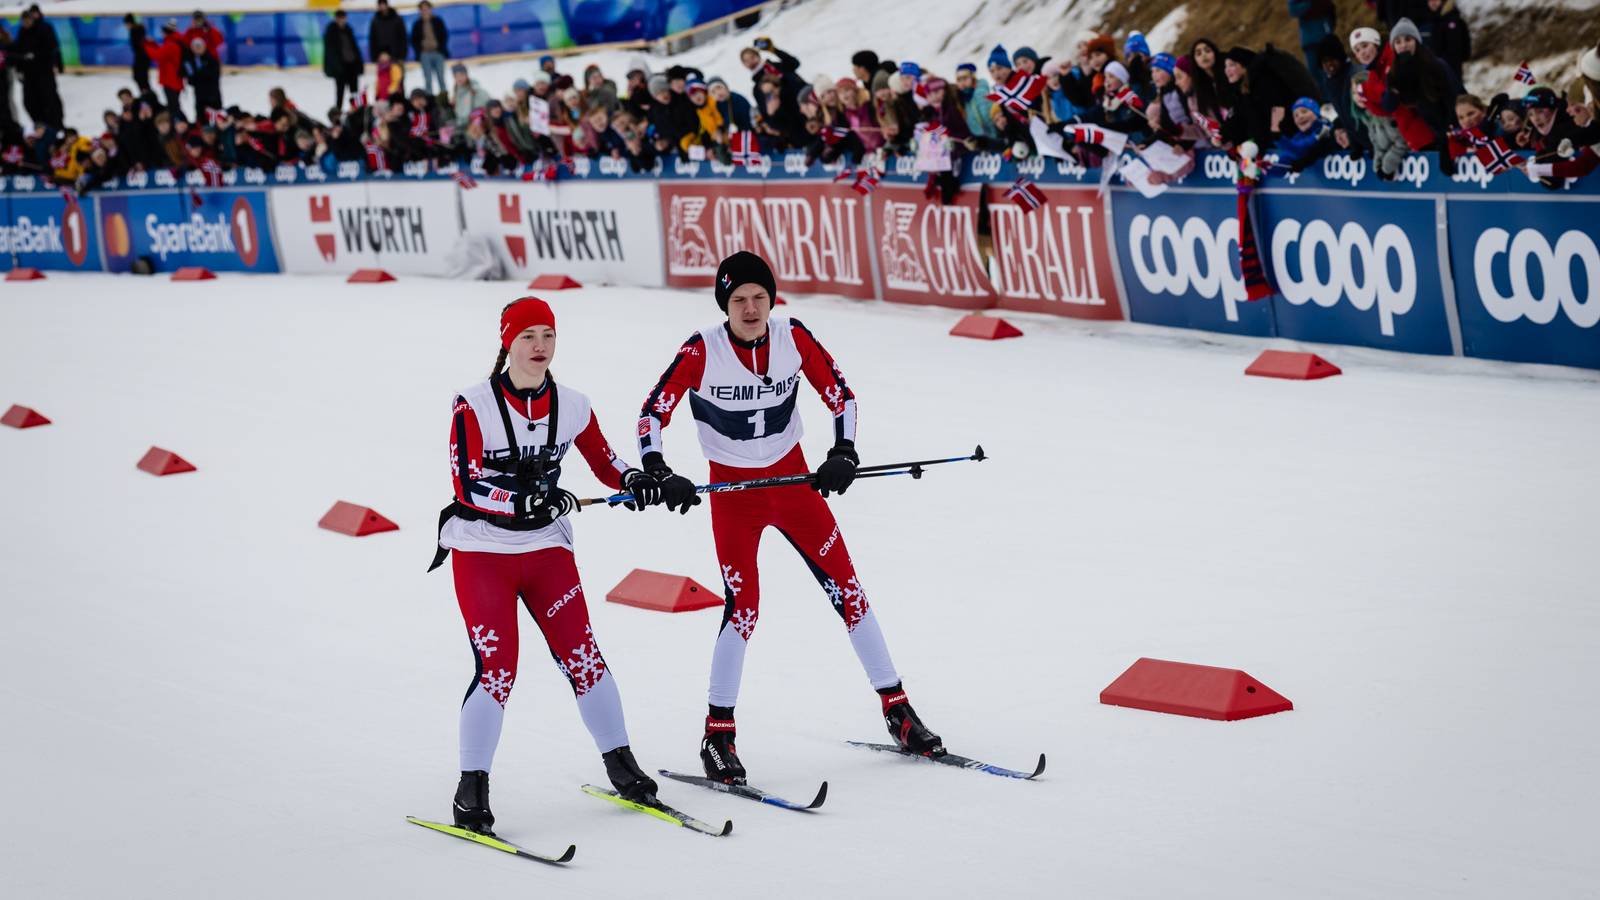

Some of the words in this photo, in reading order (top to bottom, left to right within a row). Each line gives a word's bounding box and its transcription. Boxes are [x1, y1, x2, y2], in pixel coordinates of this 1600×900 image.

[1324, 155, 1366, 187] coop
[1394, 155, 1429, 188] oop
[68, 211, 82, 255] 1
[145, 213, 236, 262] SpareBank
[236, 208, 252, 254] 1
[338, 207, 428, 254] WÜRTH
[528, 209, 624, 261] WÜRTH
[714, 195, 864, 286] GENERALI
[921, 203, 1106, 306] GENERALI
[1129, 214, 1250, 322] coop
[1271, 217, 1417, 336] coop
[709, 385, 754, 400] TEAM
[747, 409, 766, 437] 1
[547, 584, 582, 618] CRAFT
[707, 743, 727, 771] MADSHUS
